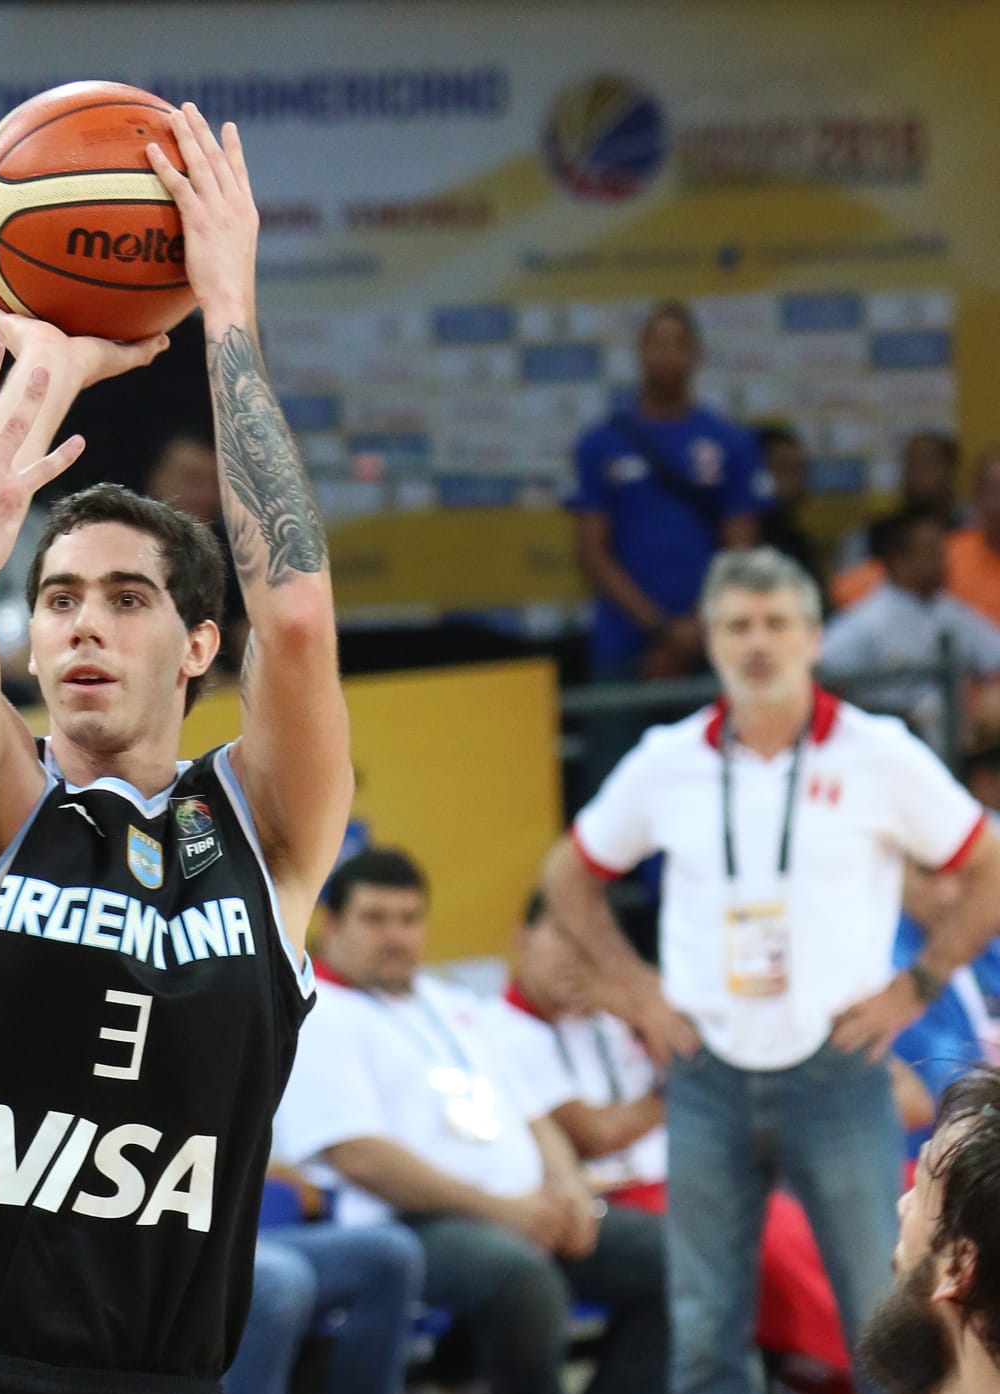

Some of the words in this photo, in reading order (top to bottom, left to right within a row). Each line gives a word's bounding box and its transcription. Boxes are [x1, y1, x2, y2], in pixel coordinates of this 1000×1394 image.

[66, 227, 185, 264] molte
[185, 836, 215, 857] FIBA
[93, 989, 153, 1080] 3
